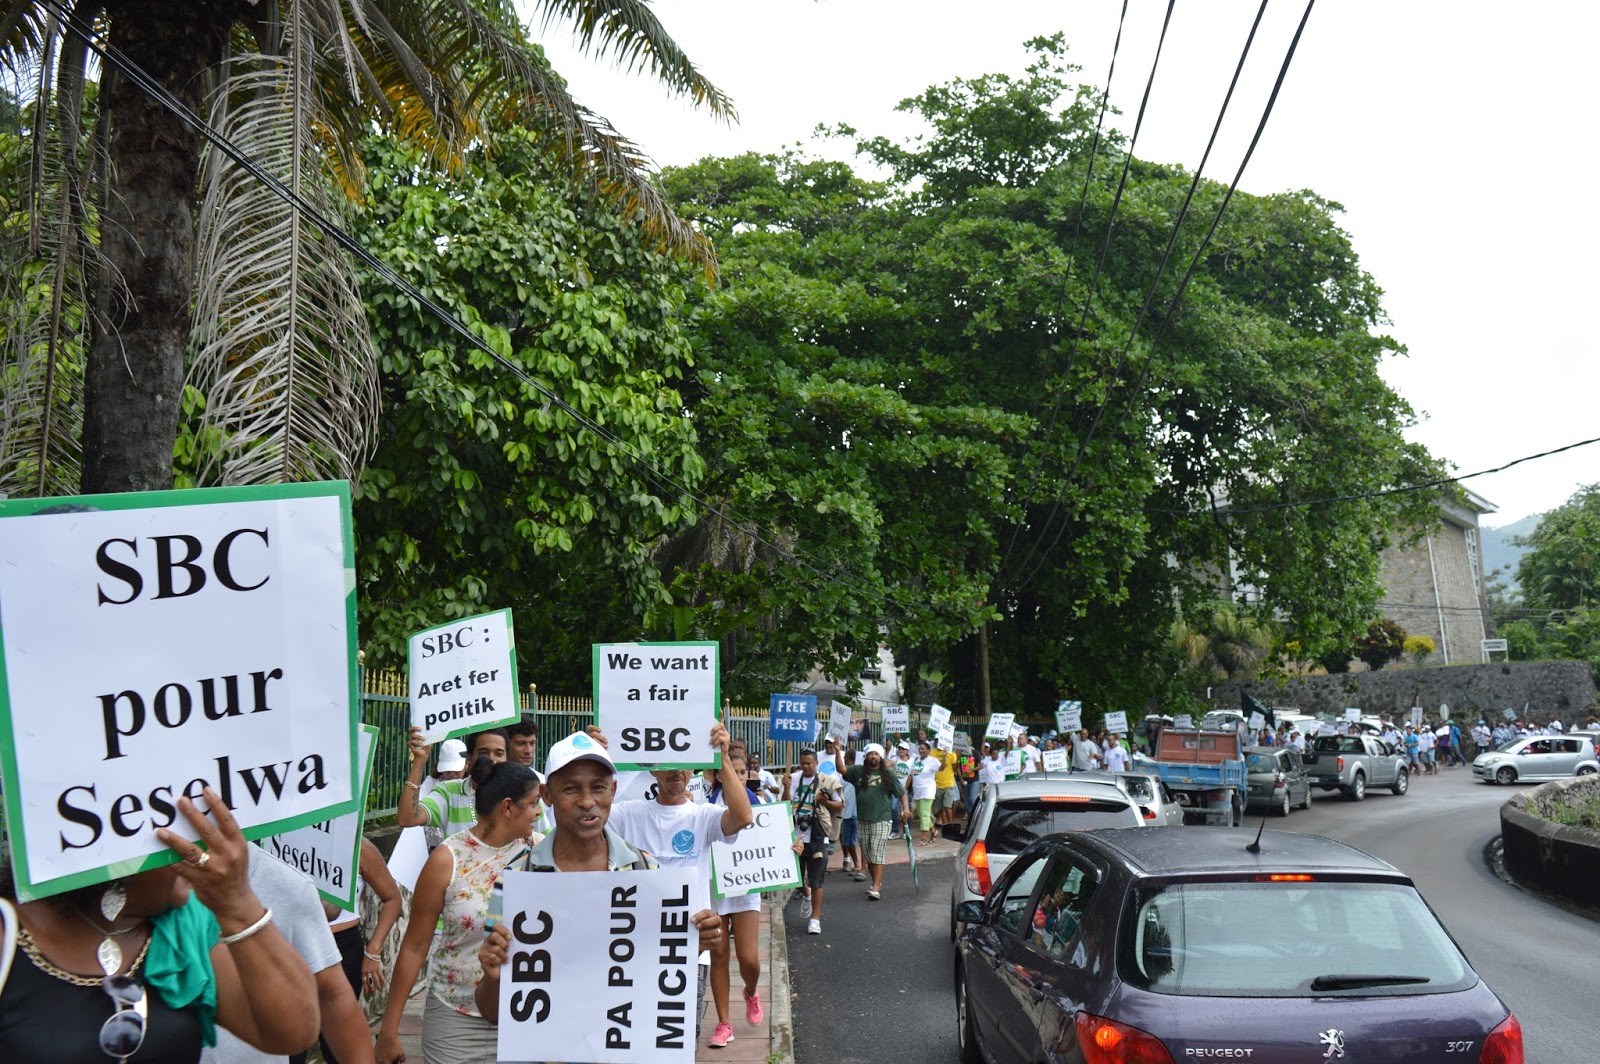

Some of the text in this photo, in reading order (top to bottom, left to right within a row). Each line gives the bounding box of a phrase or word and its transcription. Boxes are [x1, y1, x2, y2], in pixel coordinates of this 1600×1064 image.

[96, 527, 270, 607] SBC
[421, 626, 474, 659] SBC
[607, 653, 709, 670] We want
[417, 668, 499, 699] Aret fer
[627, 684, 689, 701] a fair
[96, 667, 283, 761] pour
[424, 697, 495, 730] politik
[778, 700, 807, 713] FREE
[775, 718, 808, 730] PRESS
[620, 727, 692, 752] SBC
[688, 782, 701, 791] ant
[270, 834, 344, 888] Seselwa
[732, 846, 776, 867] pour
[723, 868, 791, 887] Seselwa
[510, 910, 554, 1024] SBC
[606, 885, 637, 1049] PA POUR
[656, 884, 689, 1049] MICHEL
[1185, 1048, 1253, 1058] PEUGEOT
[1446, 1041, 1474, 1052] 307
